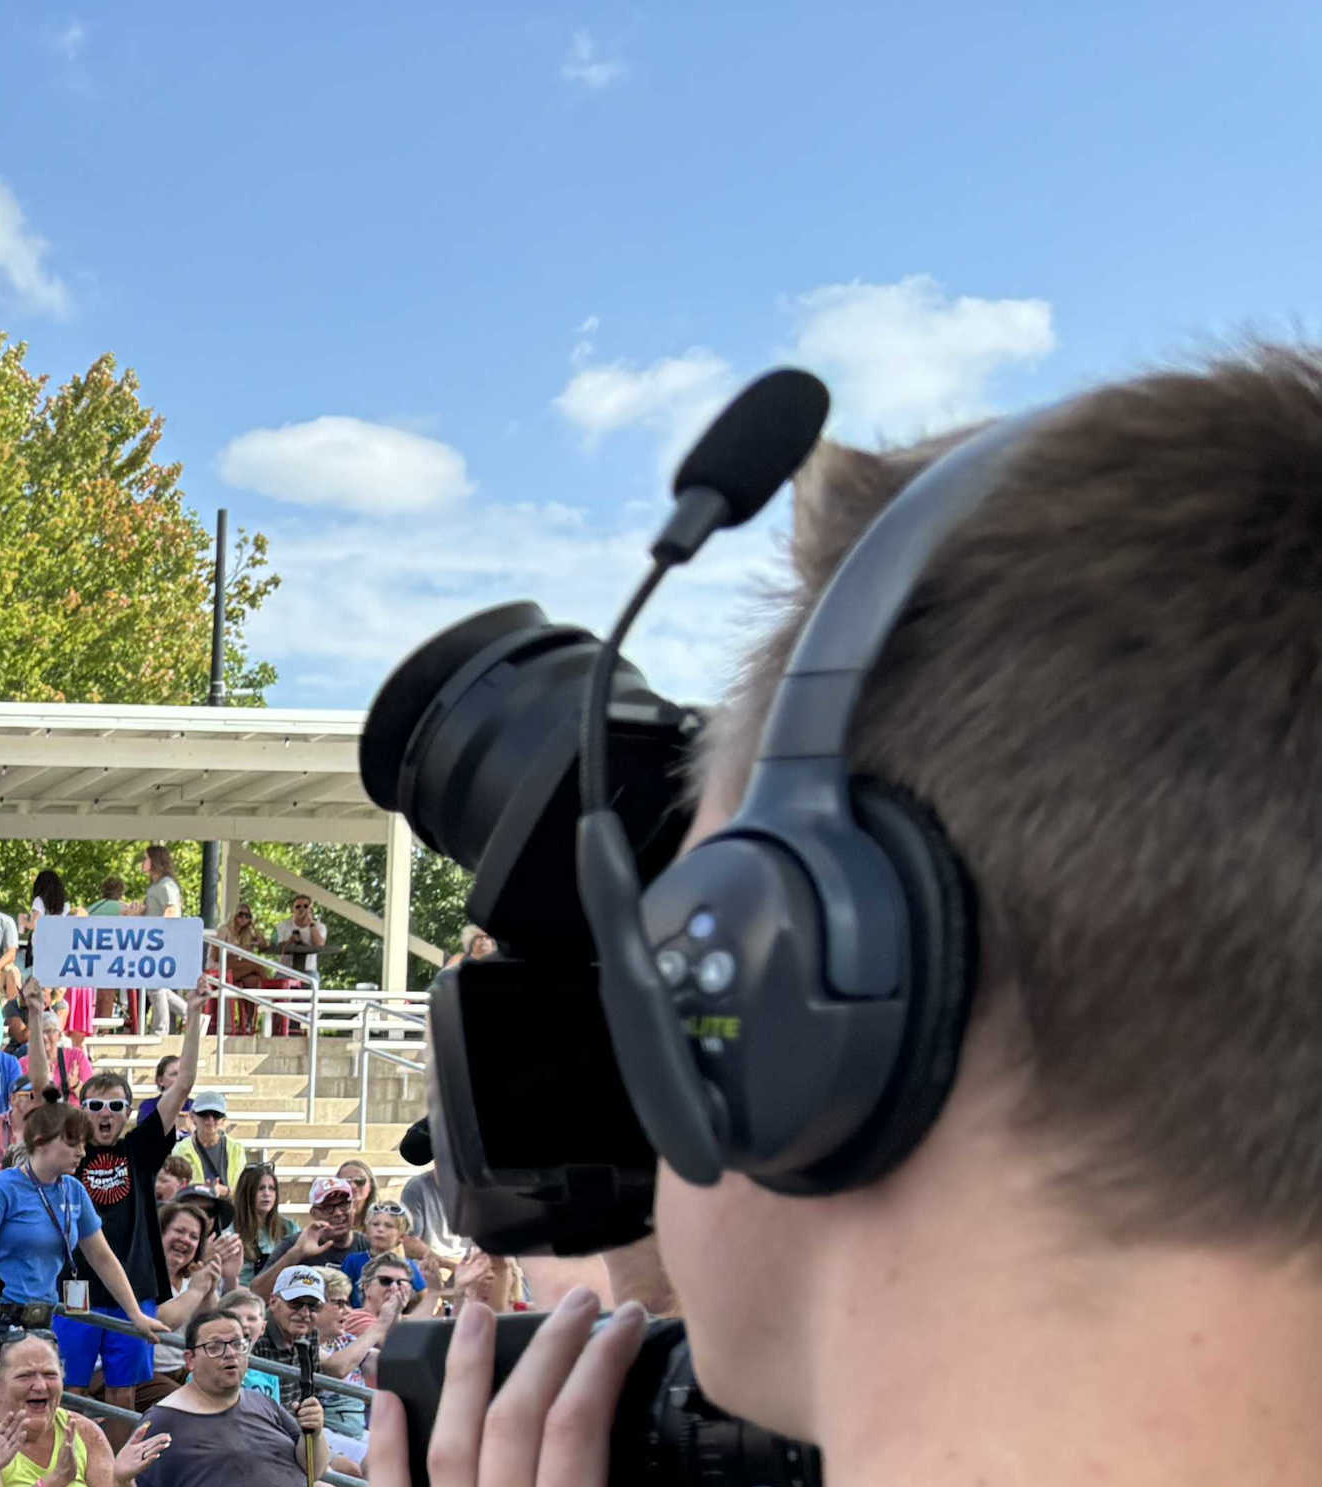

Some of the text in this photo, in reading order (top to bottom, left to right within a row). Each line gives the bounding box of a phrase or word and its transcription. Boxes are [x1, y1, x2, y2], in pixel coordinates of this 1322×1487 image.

[72, 928, 165, 951] NEWS
[59, 954, 176, 978] AT 4:00
